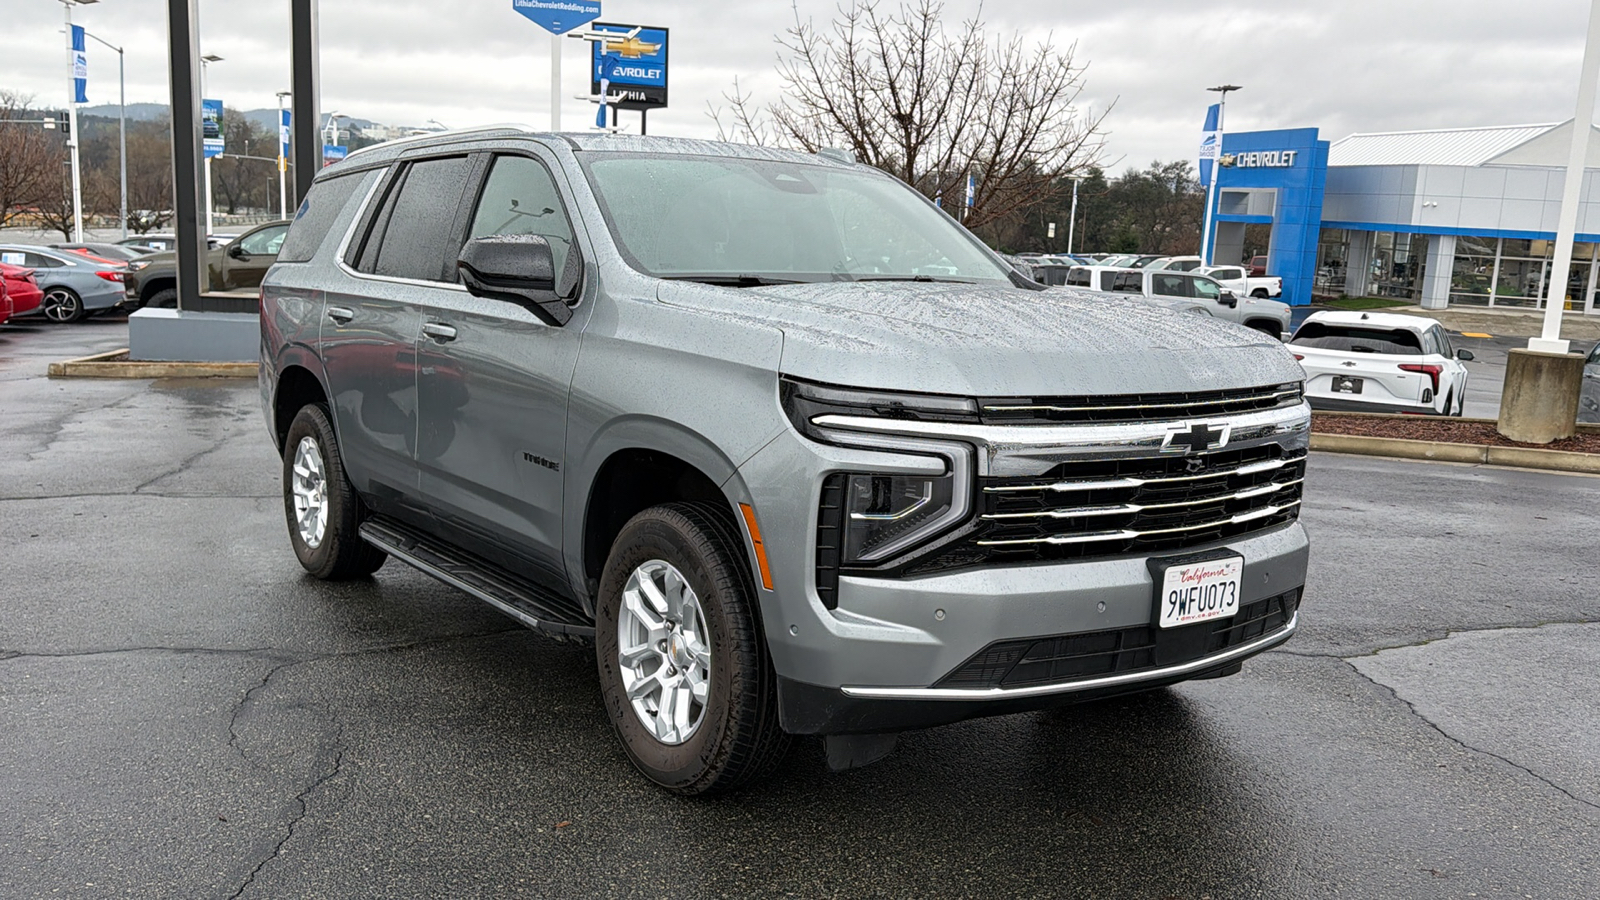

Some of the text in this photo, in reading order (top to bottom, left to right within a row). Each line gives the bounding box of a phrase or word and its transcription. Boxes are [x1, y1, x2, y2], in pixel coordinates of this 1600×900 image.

[515, 0, 599, 13] LithiaChevroletRedding.com
[598, 65, 661, 79] CEVROLET
[612, 89, 647, 101] LHIA
[1236, 151, 1297, 167] CHEVROLET
[1181, 567, 1228, 584] California
[1167, 581, 1236, 618] 9WFU073
